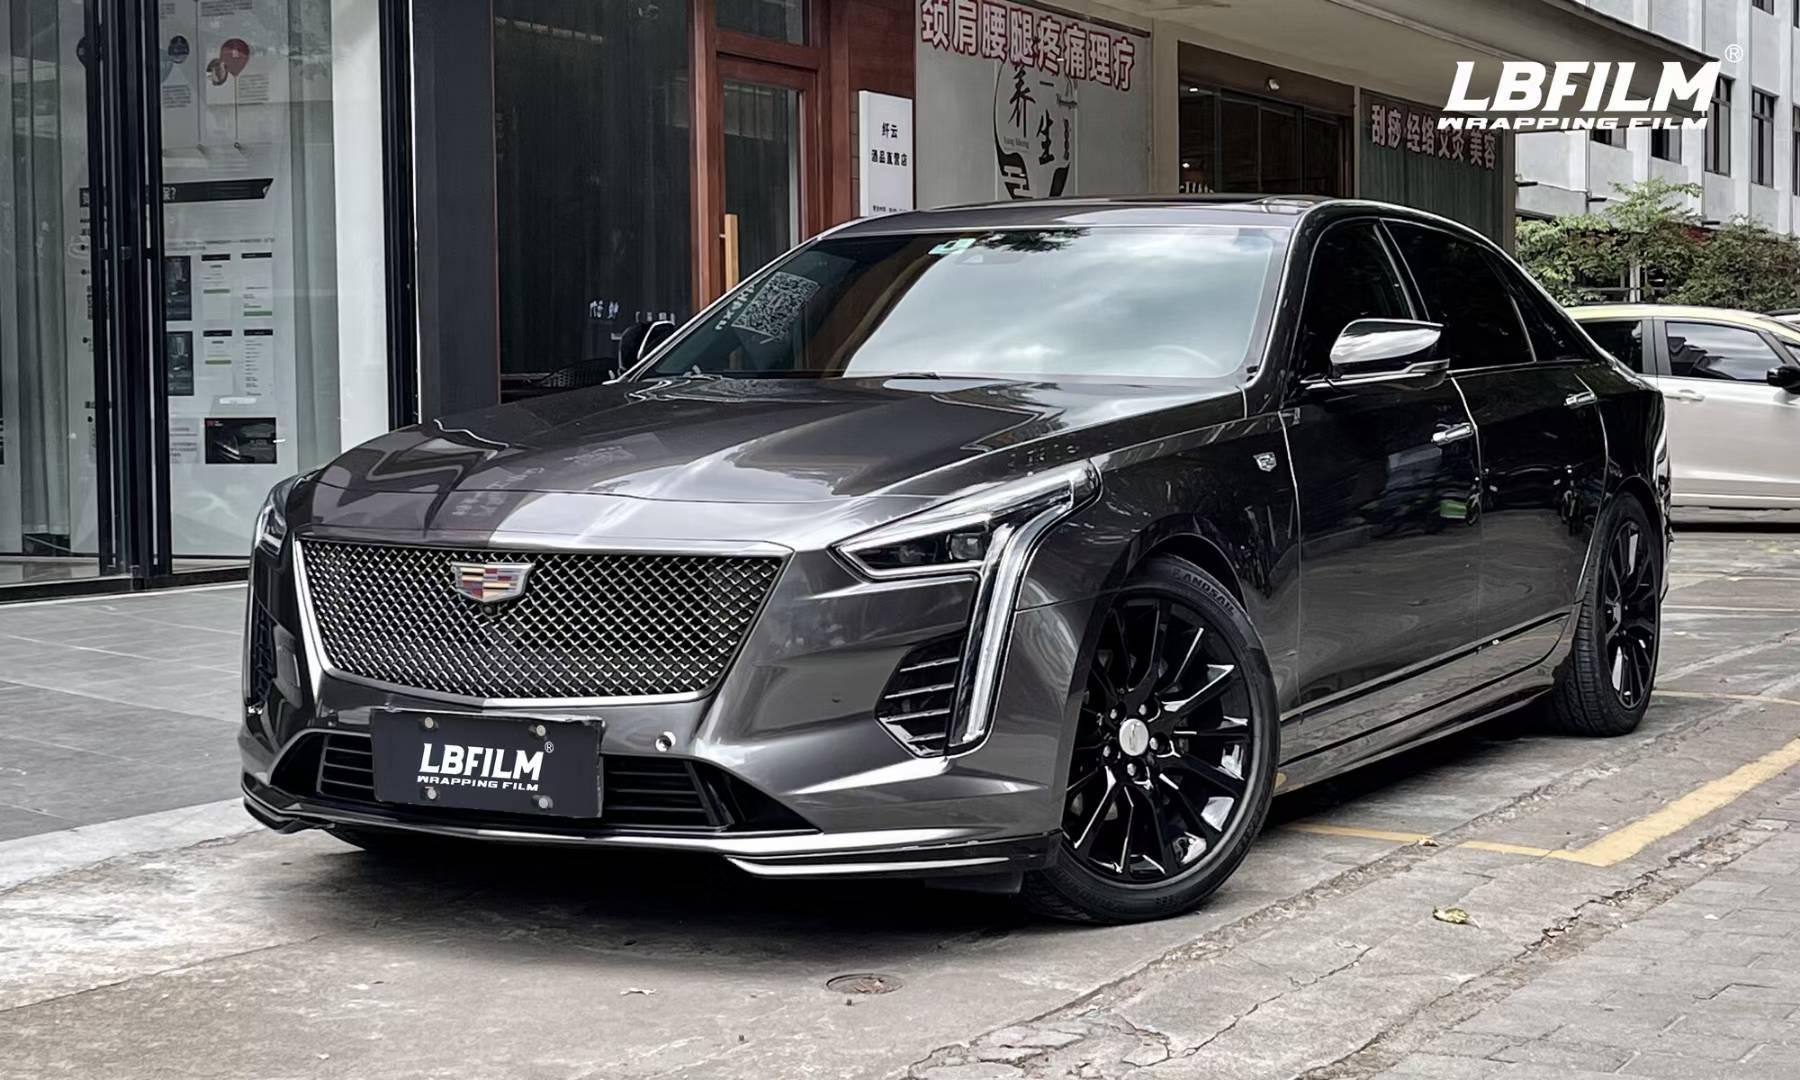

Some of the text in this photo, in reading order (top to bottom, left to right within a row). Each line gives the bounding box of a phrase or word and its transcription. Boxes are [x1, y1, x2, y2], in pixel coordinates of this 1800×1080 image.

[920, 0, 1135, 91] 颈肩腰腿疼痛理疗
[418, 742, 545, 781] LBFILM
[416, 775, 540, 792] WRAPPING FILM
